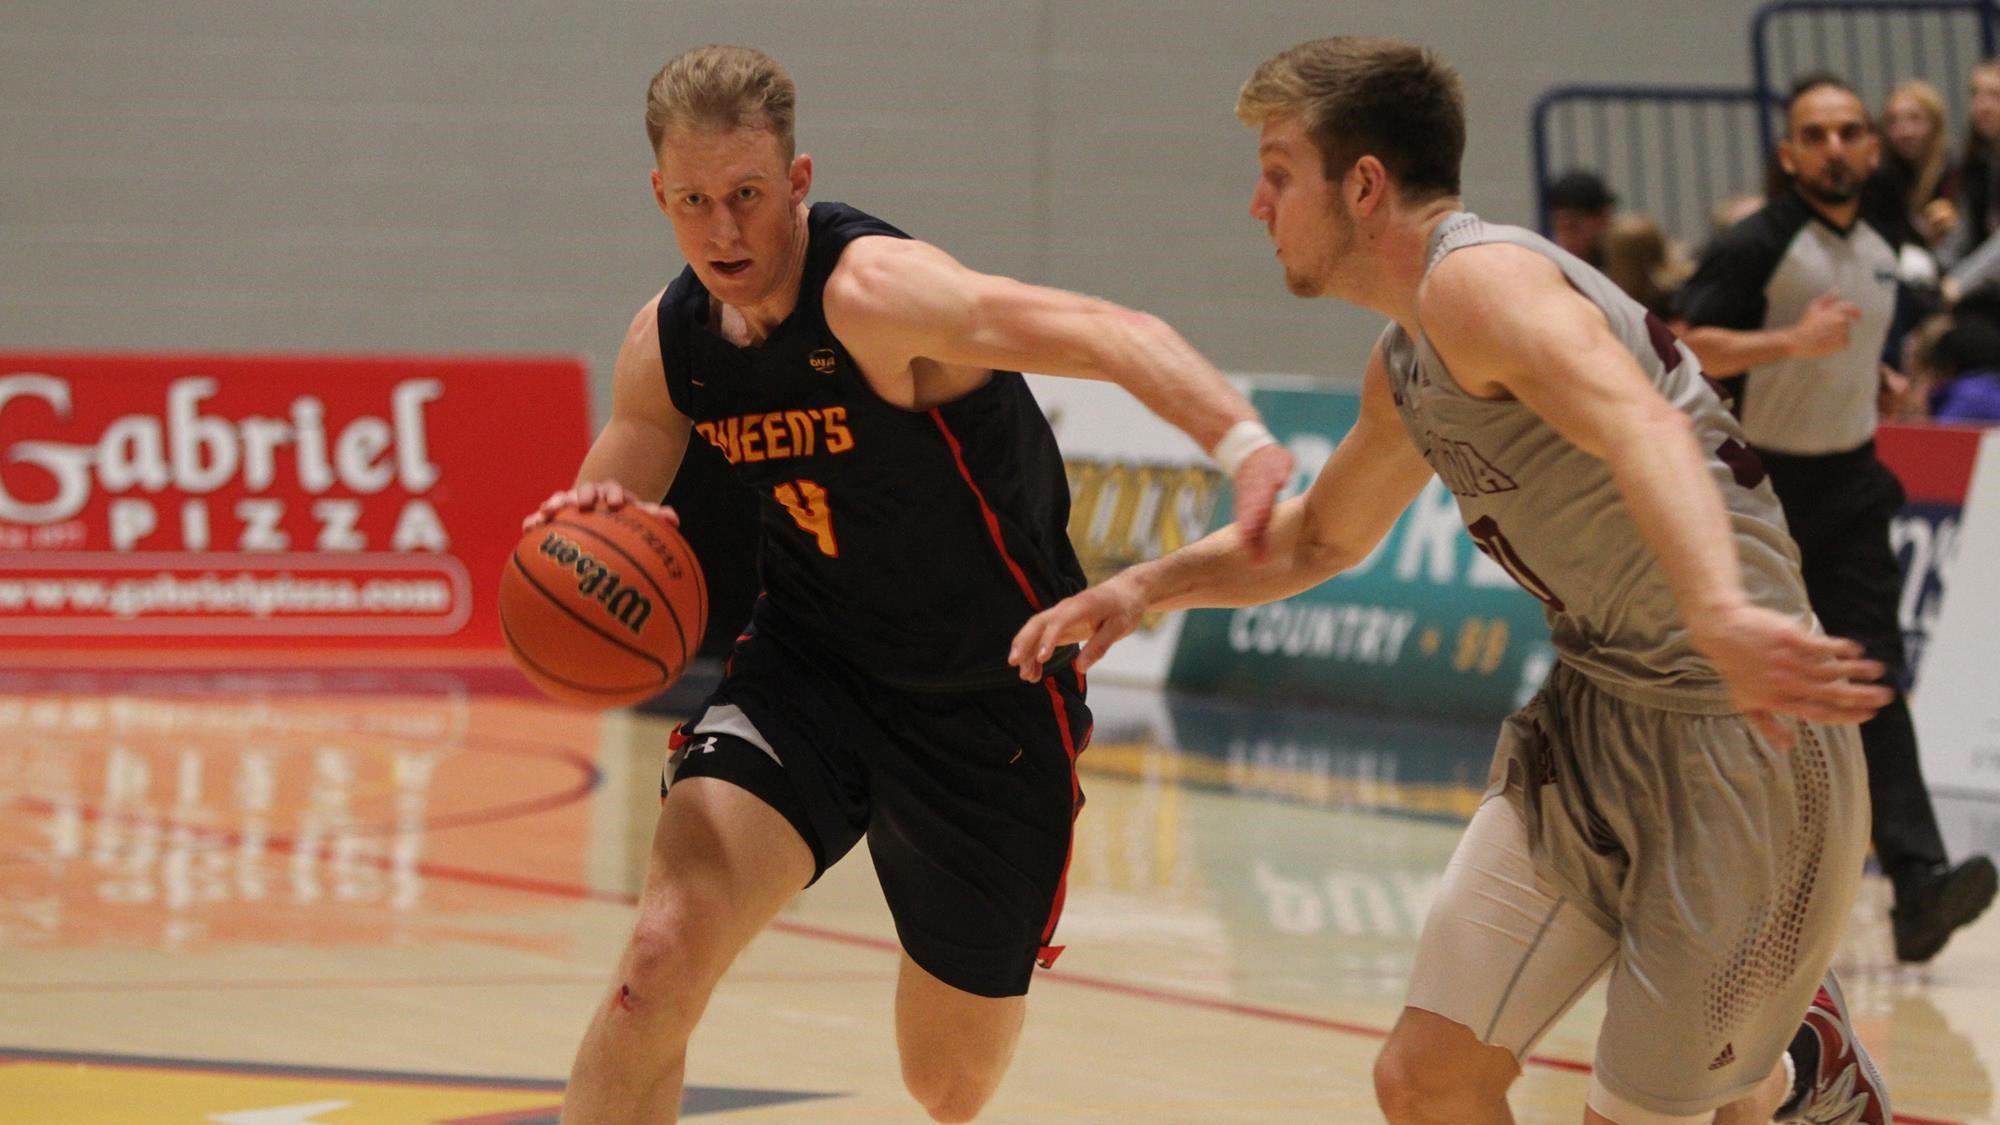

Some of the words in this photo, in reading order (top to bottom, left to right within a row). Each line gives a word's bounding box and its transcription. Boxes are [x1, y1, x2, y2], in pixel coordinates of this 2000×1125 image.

[0, 373, 443, 524] Gabriel
[109, 499, 450, 551] PIZZA
[773, 479, 839, 558] 4
[538, 532, 652, 636] Wilson
